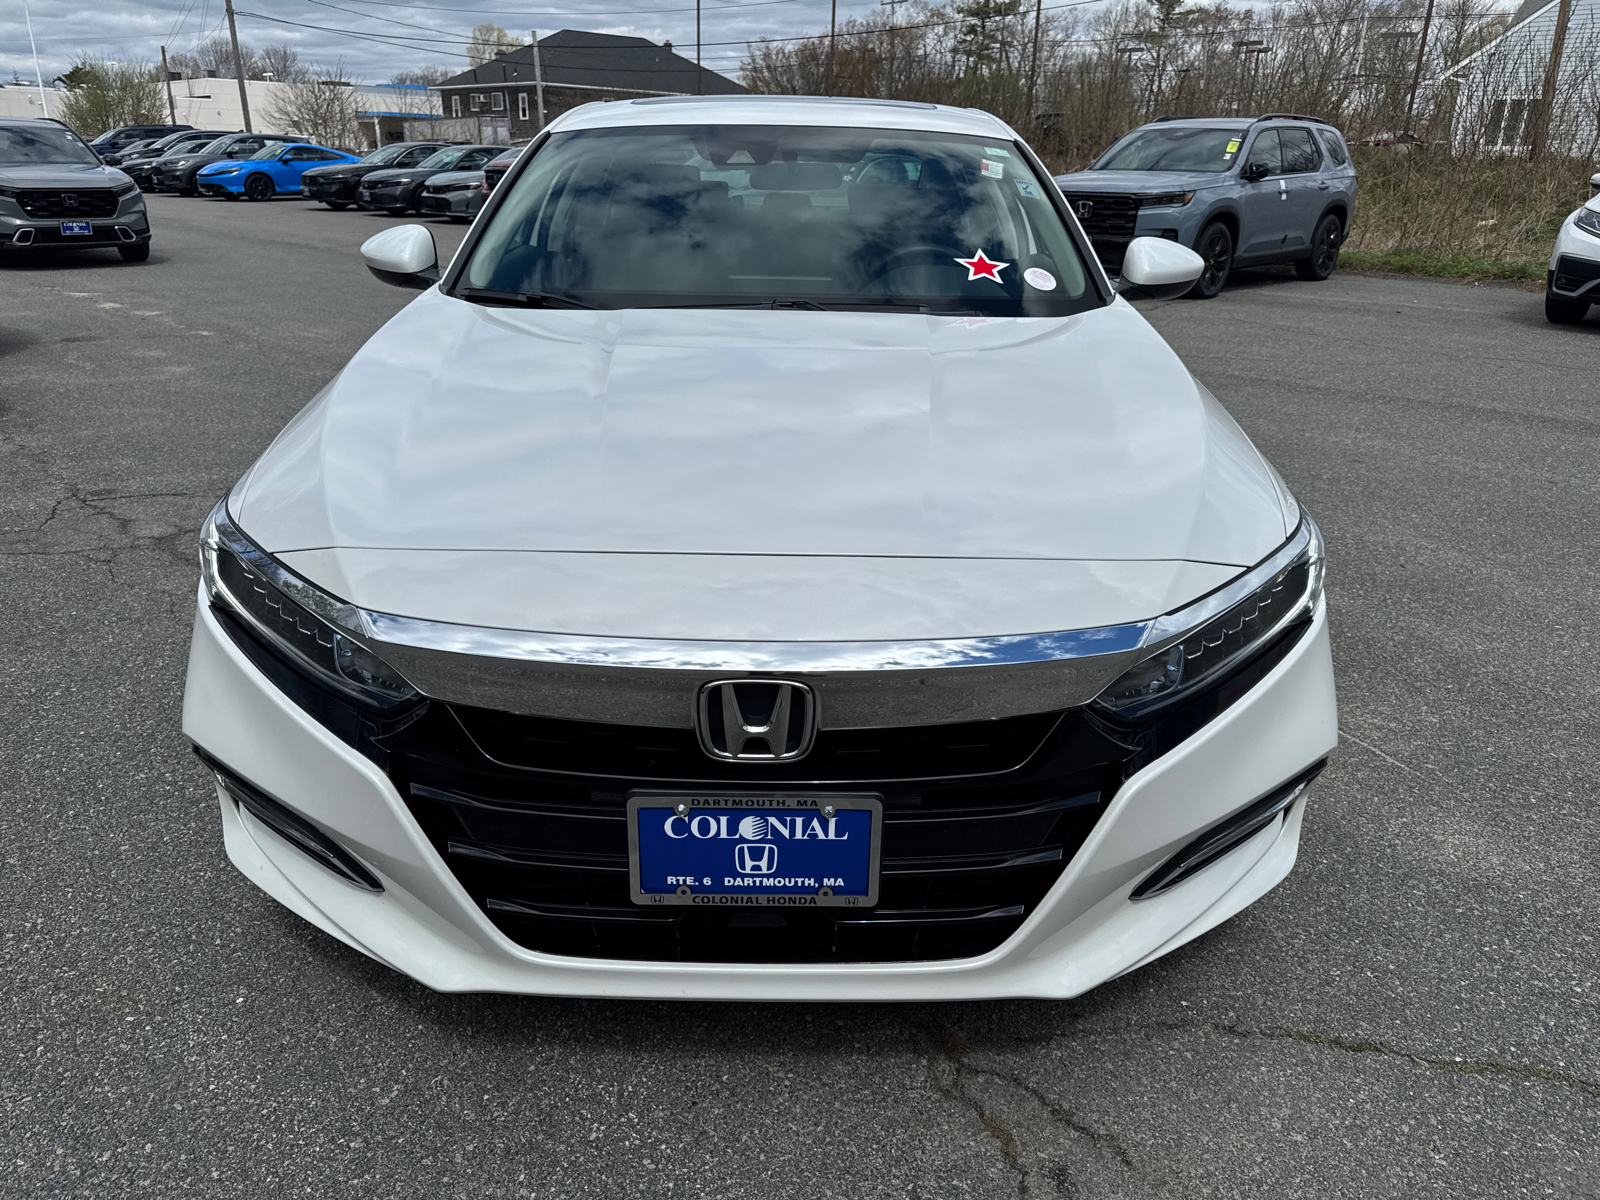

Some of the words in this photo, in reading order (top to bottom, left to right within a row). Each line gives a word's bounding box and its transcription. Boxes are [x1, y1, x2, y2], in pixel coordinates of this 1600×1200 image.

[691, 798, 791, 808] DARTMOUTH,
[796, 799, 819, 807] MA
[664, 815, 849, 841] COLONIAL
[667, 876, 699, 886] RTE.
[702, 876, 712, 886] 6
[724, 876, 819, 889] DARTMOUTH,
[823, 877, 845, 887] MA
[692, 895, 763, 905] COLONIAL
[766, 896, 818, 906] HONDA
